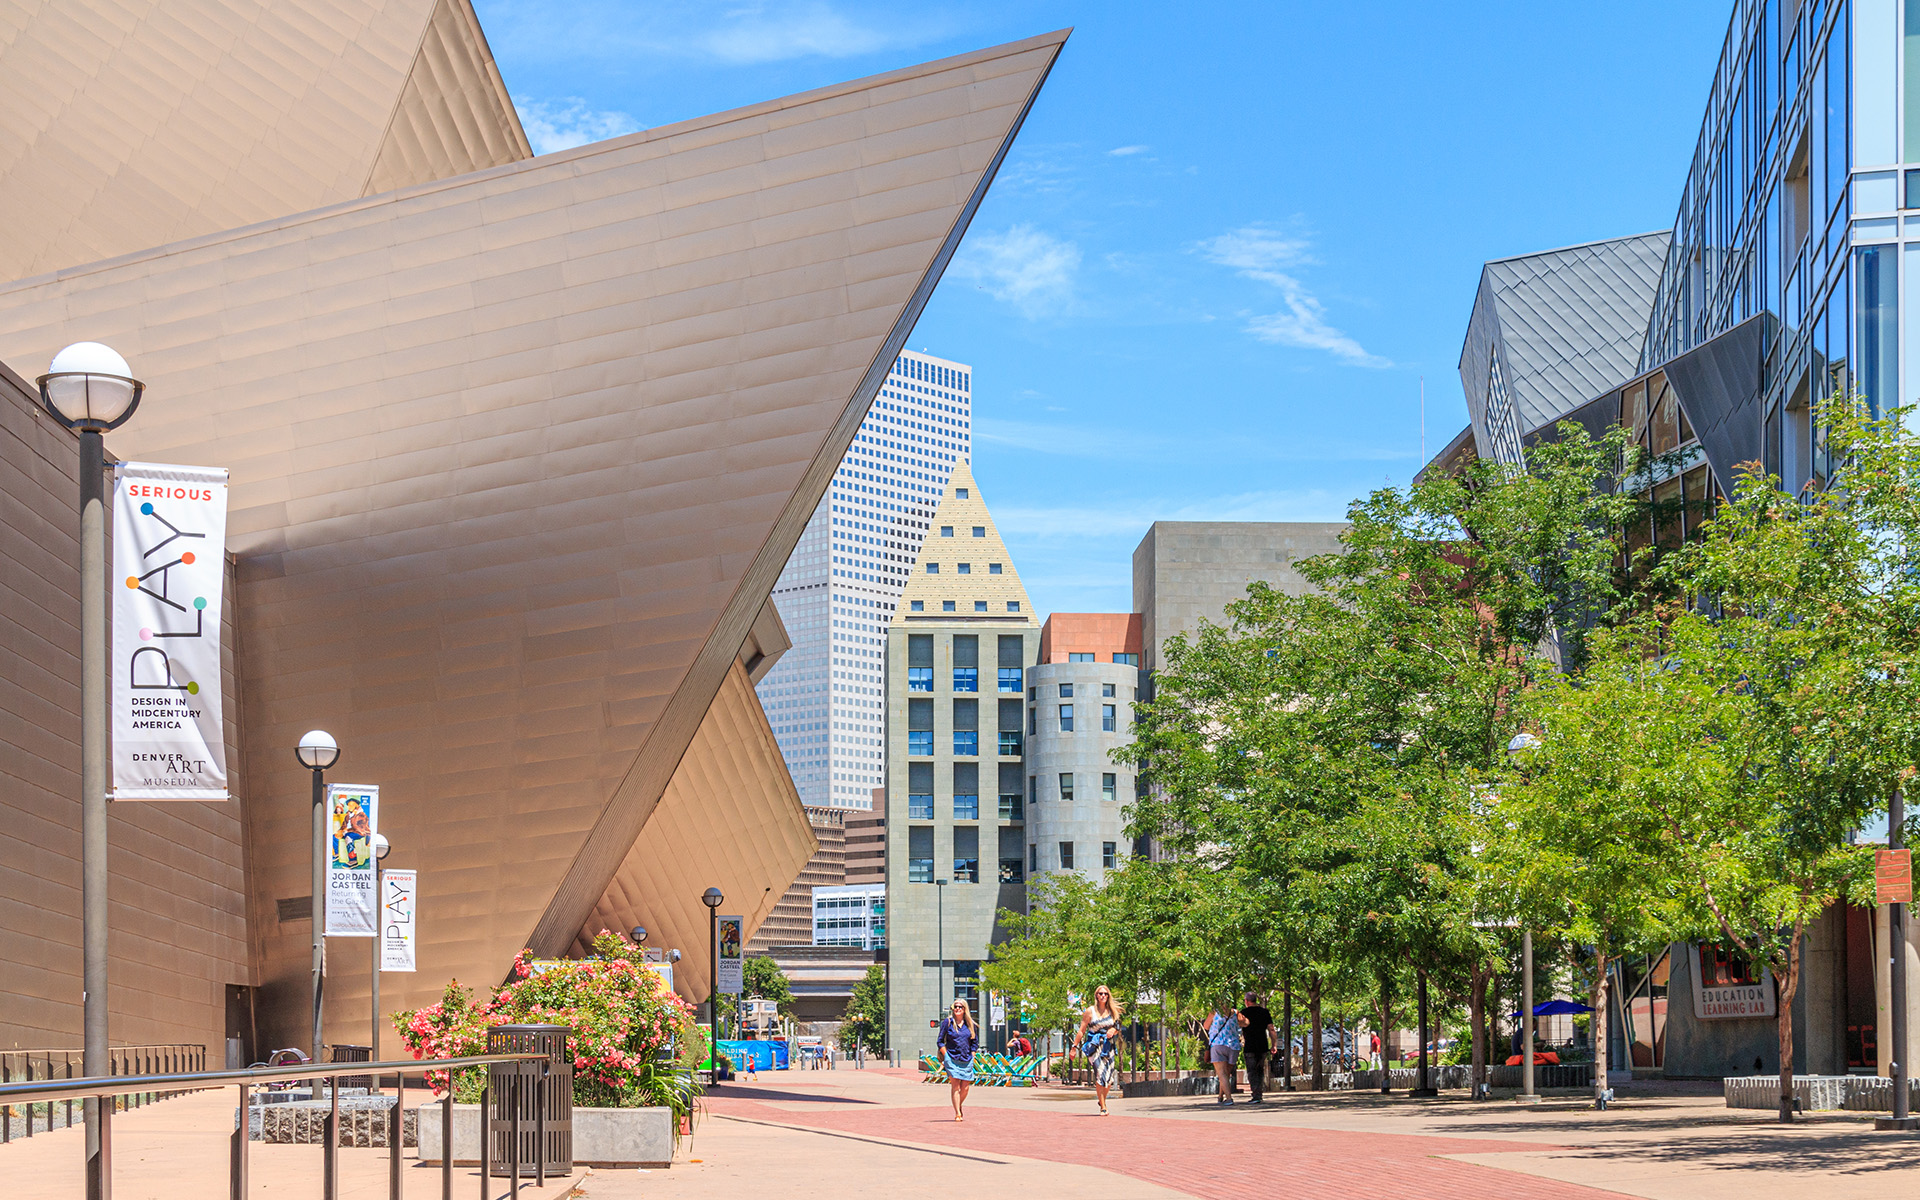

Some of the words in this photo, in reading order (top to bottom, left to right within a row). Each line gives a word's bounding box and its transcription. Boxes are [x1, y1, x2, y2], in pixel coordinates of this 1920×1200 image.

[129, 485, 212, 501] SERIOUS
[126, 502, 207, 695] PLAY
[131, 698, 171, 706] DESIGN
[176, 698, 186, 706] IN
[131, 710, 201, 718] MIDCENTURY
[132, 721, 182, 729] AMERICA
[133, 754, 183, 762] DENVER
[166, 760, 206, 773] ART
[143, 778, 198, 786] MUSEUM
[332, 873, 371, 881] JORDAN
[331, 881, 371, 889] CASTEEL
[385, 881, 411, 939] PLAY
[1702, 989, 1764, 1002] EDUCATION
[1703, 1002, 1745, 1015] LEARNING
[1749, 1002, 1765, 1013] LAB
